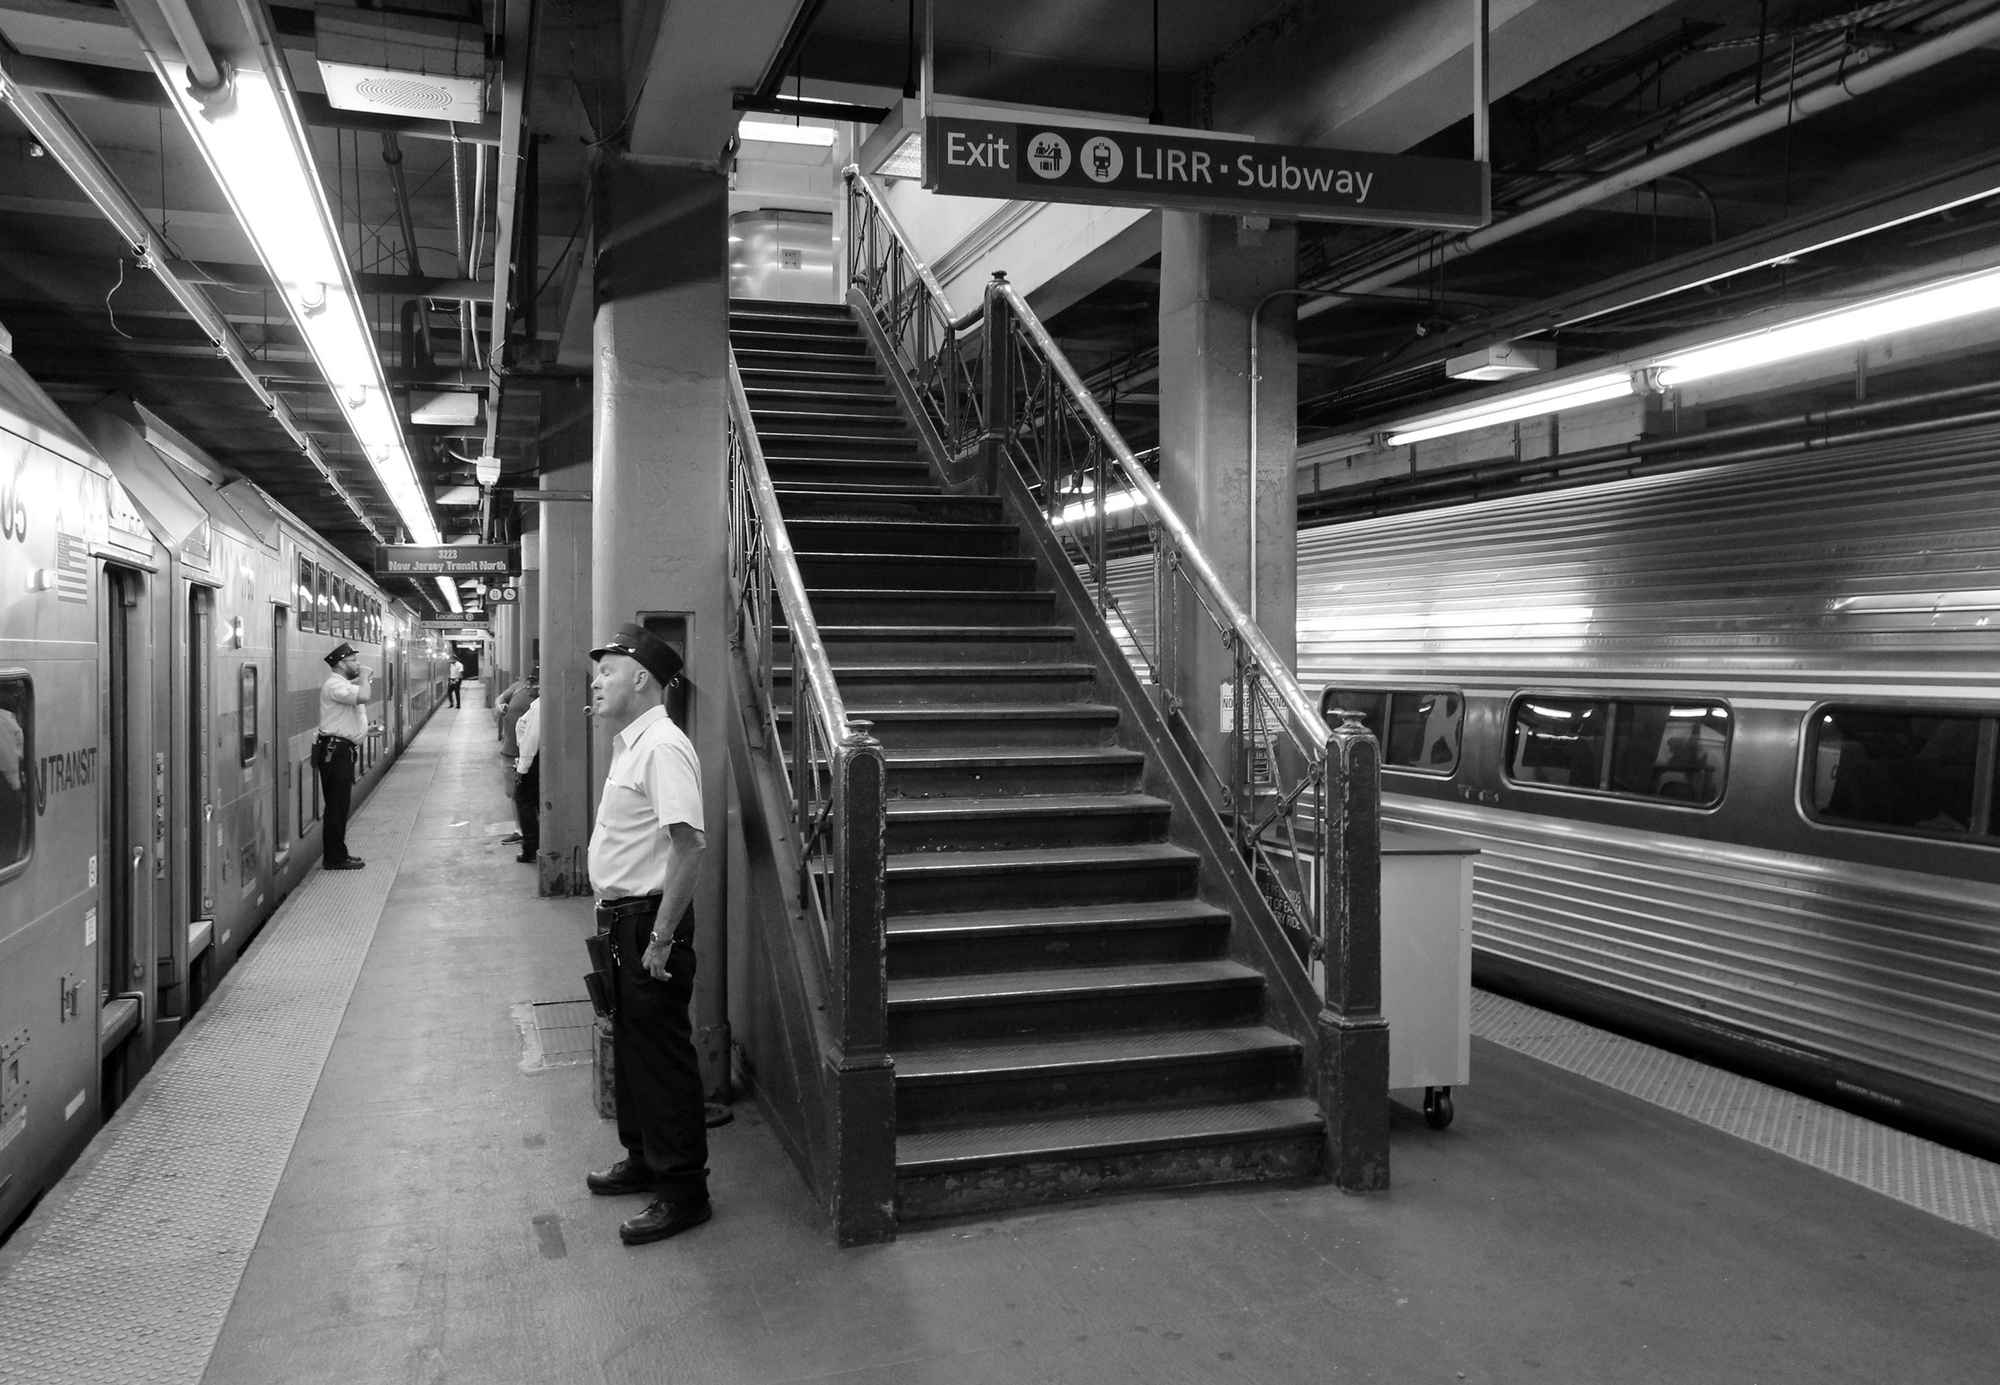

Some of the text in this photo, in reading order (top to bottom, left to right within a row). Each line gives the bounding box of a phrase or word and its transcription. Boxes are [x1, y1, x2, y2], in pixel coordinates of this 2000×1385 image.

[946, 131, 1374, 203] Exit LIRR Subway
[0, 486, 27, 544] 05
[388, 561, 506, 573] New Jersey Transit North
[438, 549, 458, 560] 3223
[48, 746, 97, 795] TRANSIT
